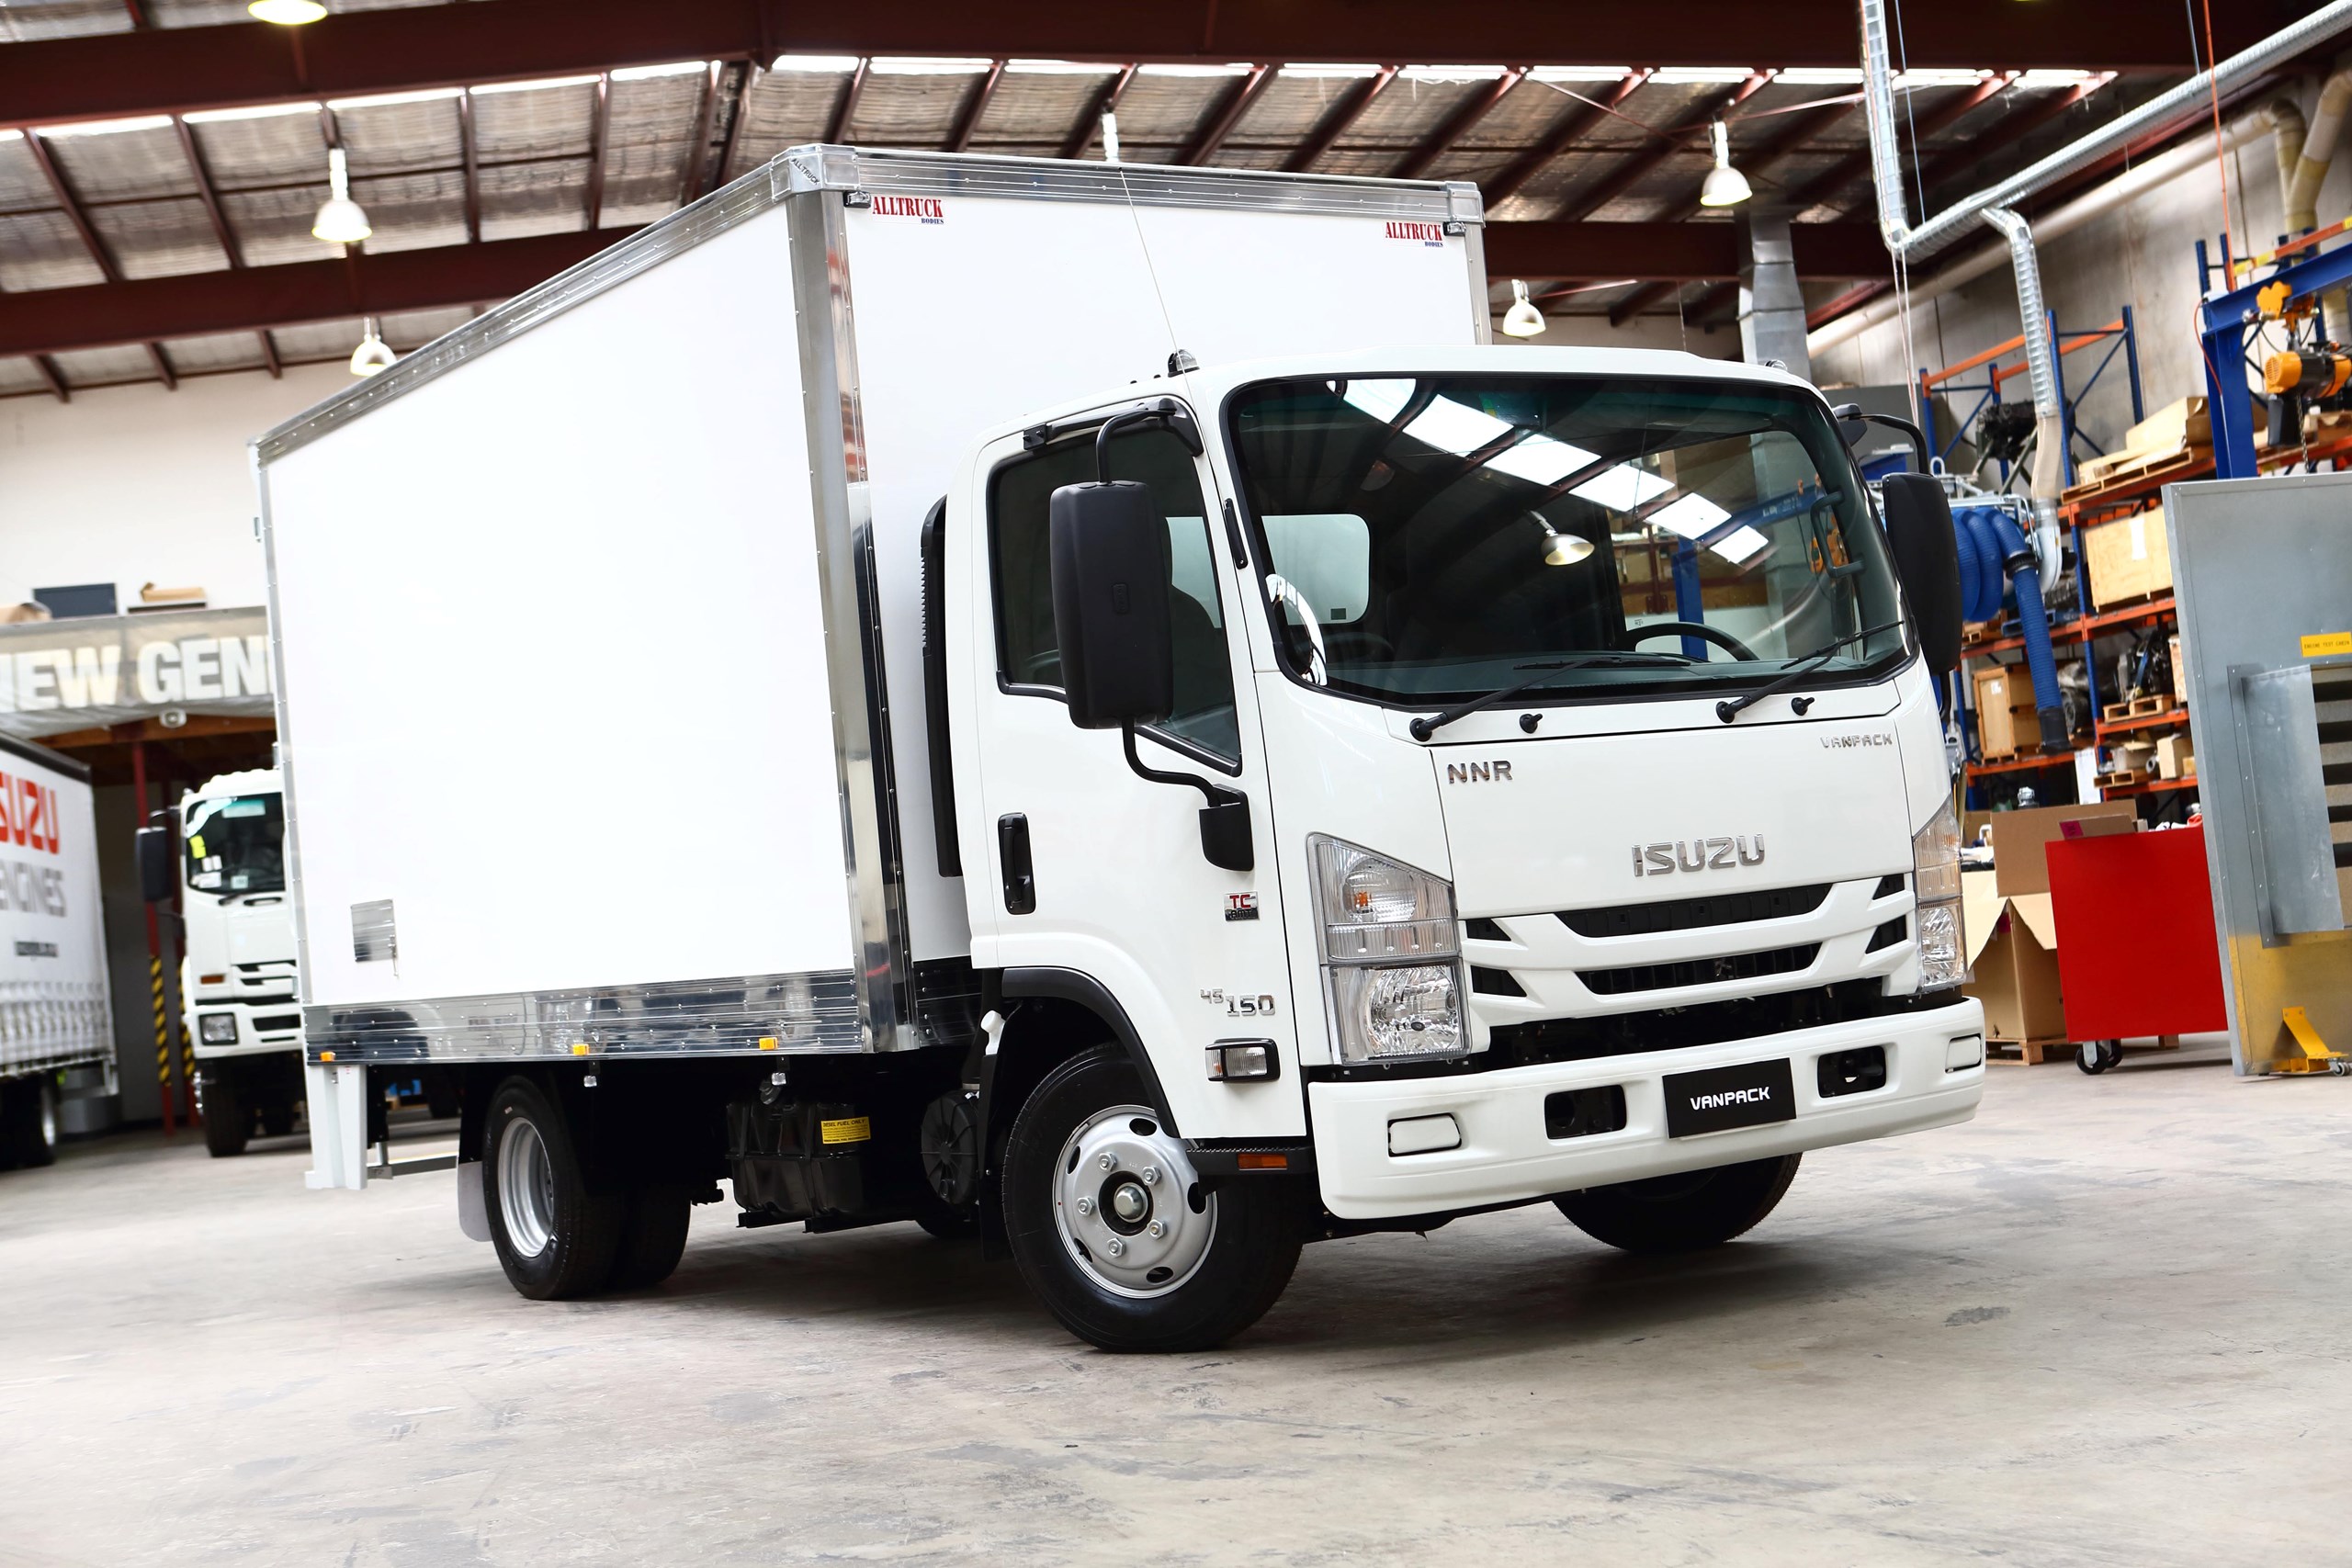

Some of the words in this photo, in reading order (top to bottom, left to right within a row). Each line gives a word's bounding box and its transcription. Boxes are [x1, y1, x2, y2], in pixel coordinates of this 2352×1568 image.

[791, 158, 820, 186] ALLTRUCK
[873, 196, 944, 218] ALLTRUCK
[1385, 221, 1443, 242] ALLTRUCK
[1820, 734, 1893, 749] VANPACK
[1447, 761, 1513, 784] NNR
[1632, 833, 1765, 877] ISUZU
[1229, 894, 1251, 908] TC
[1200, 988, 1224, 1004] 45
[1226, 994, 1276, 1016] 150
[1690, 1086, 1770, 1111] VANPACK
